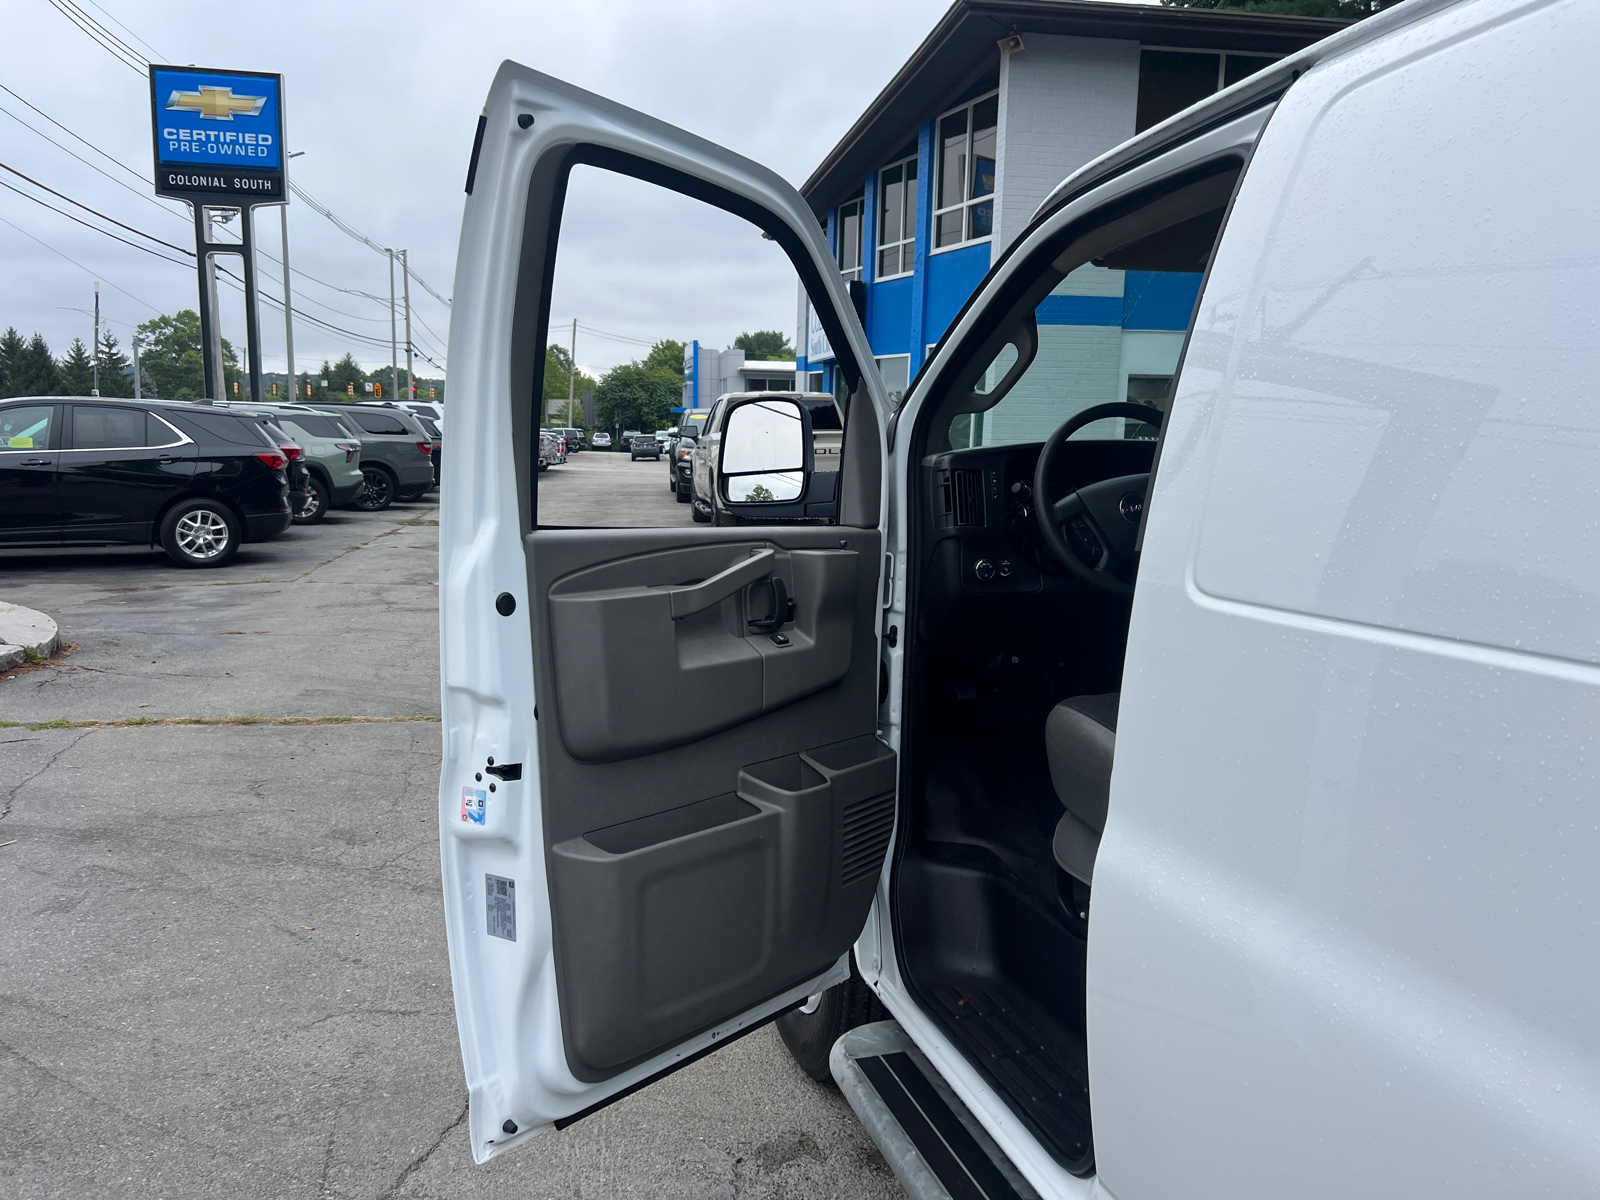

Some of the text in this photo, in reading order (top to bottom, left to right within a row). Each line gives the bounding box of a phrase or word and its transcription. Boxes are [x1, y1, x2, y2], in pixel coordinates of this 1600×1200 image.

[163, 128, 272, 145] CERTIFIED
[169, 141, 267, 157] PRE-OWNED
[168, 174, 272, 190] COLONIAL SOUTH
